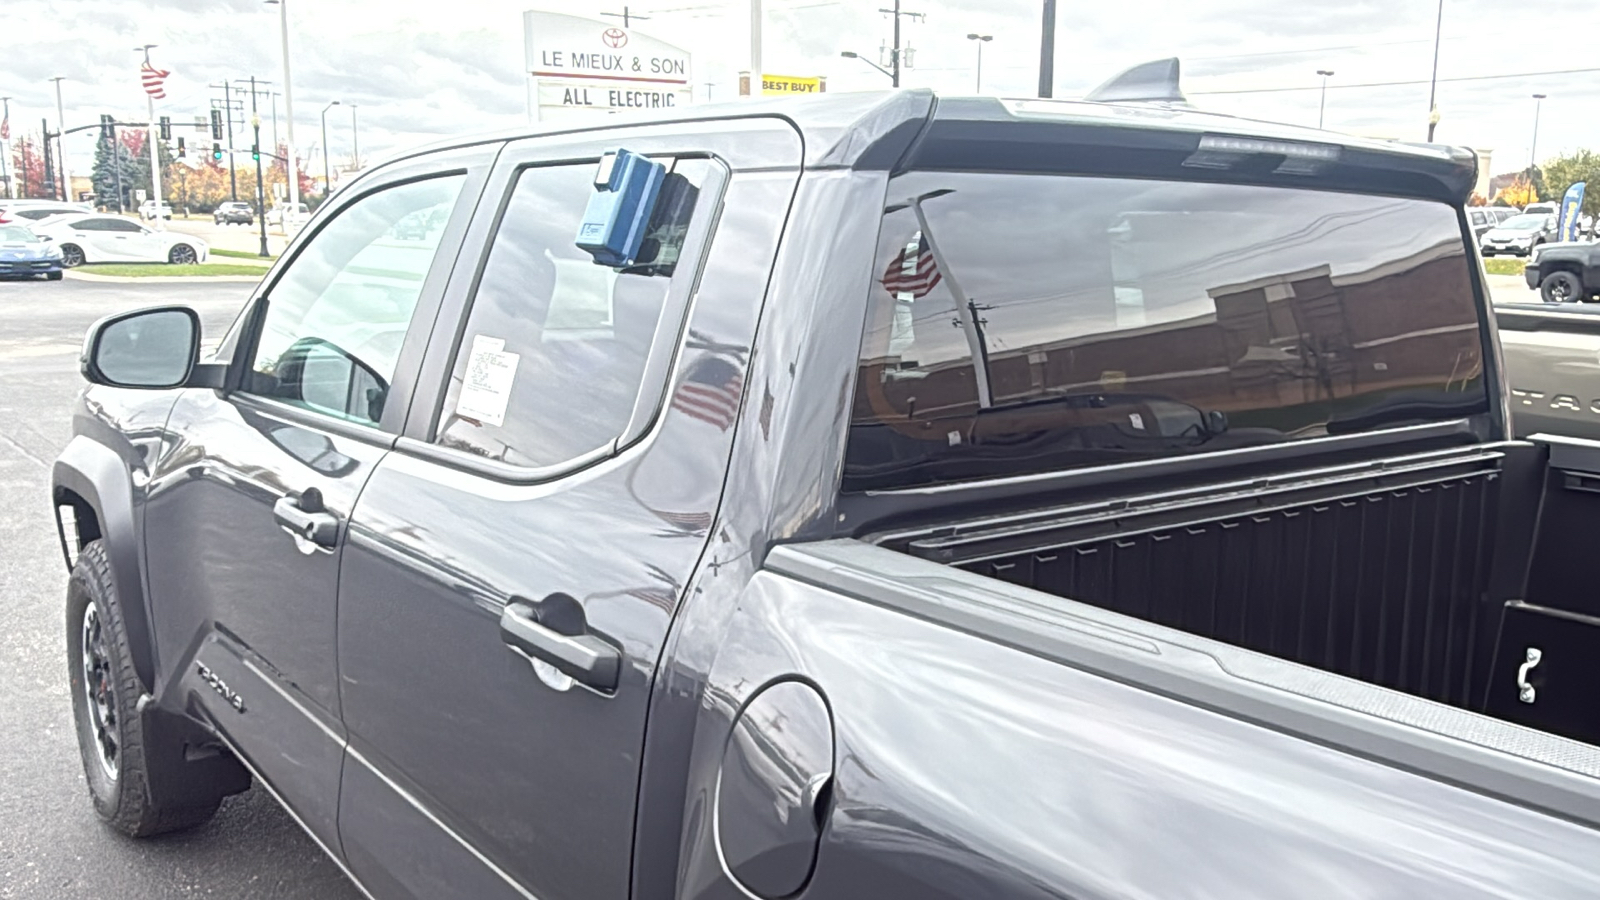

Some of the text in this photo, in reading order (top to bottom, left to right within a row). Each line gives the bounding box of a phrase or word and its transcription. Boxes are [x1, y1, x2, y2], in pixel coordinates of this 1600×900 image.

[542, 50, 685, 74] LE MIEUX & SON
[762, 80, 815, 93] BEST BUY
[562, 87, 676, 108] ALL ELECTRIC
